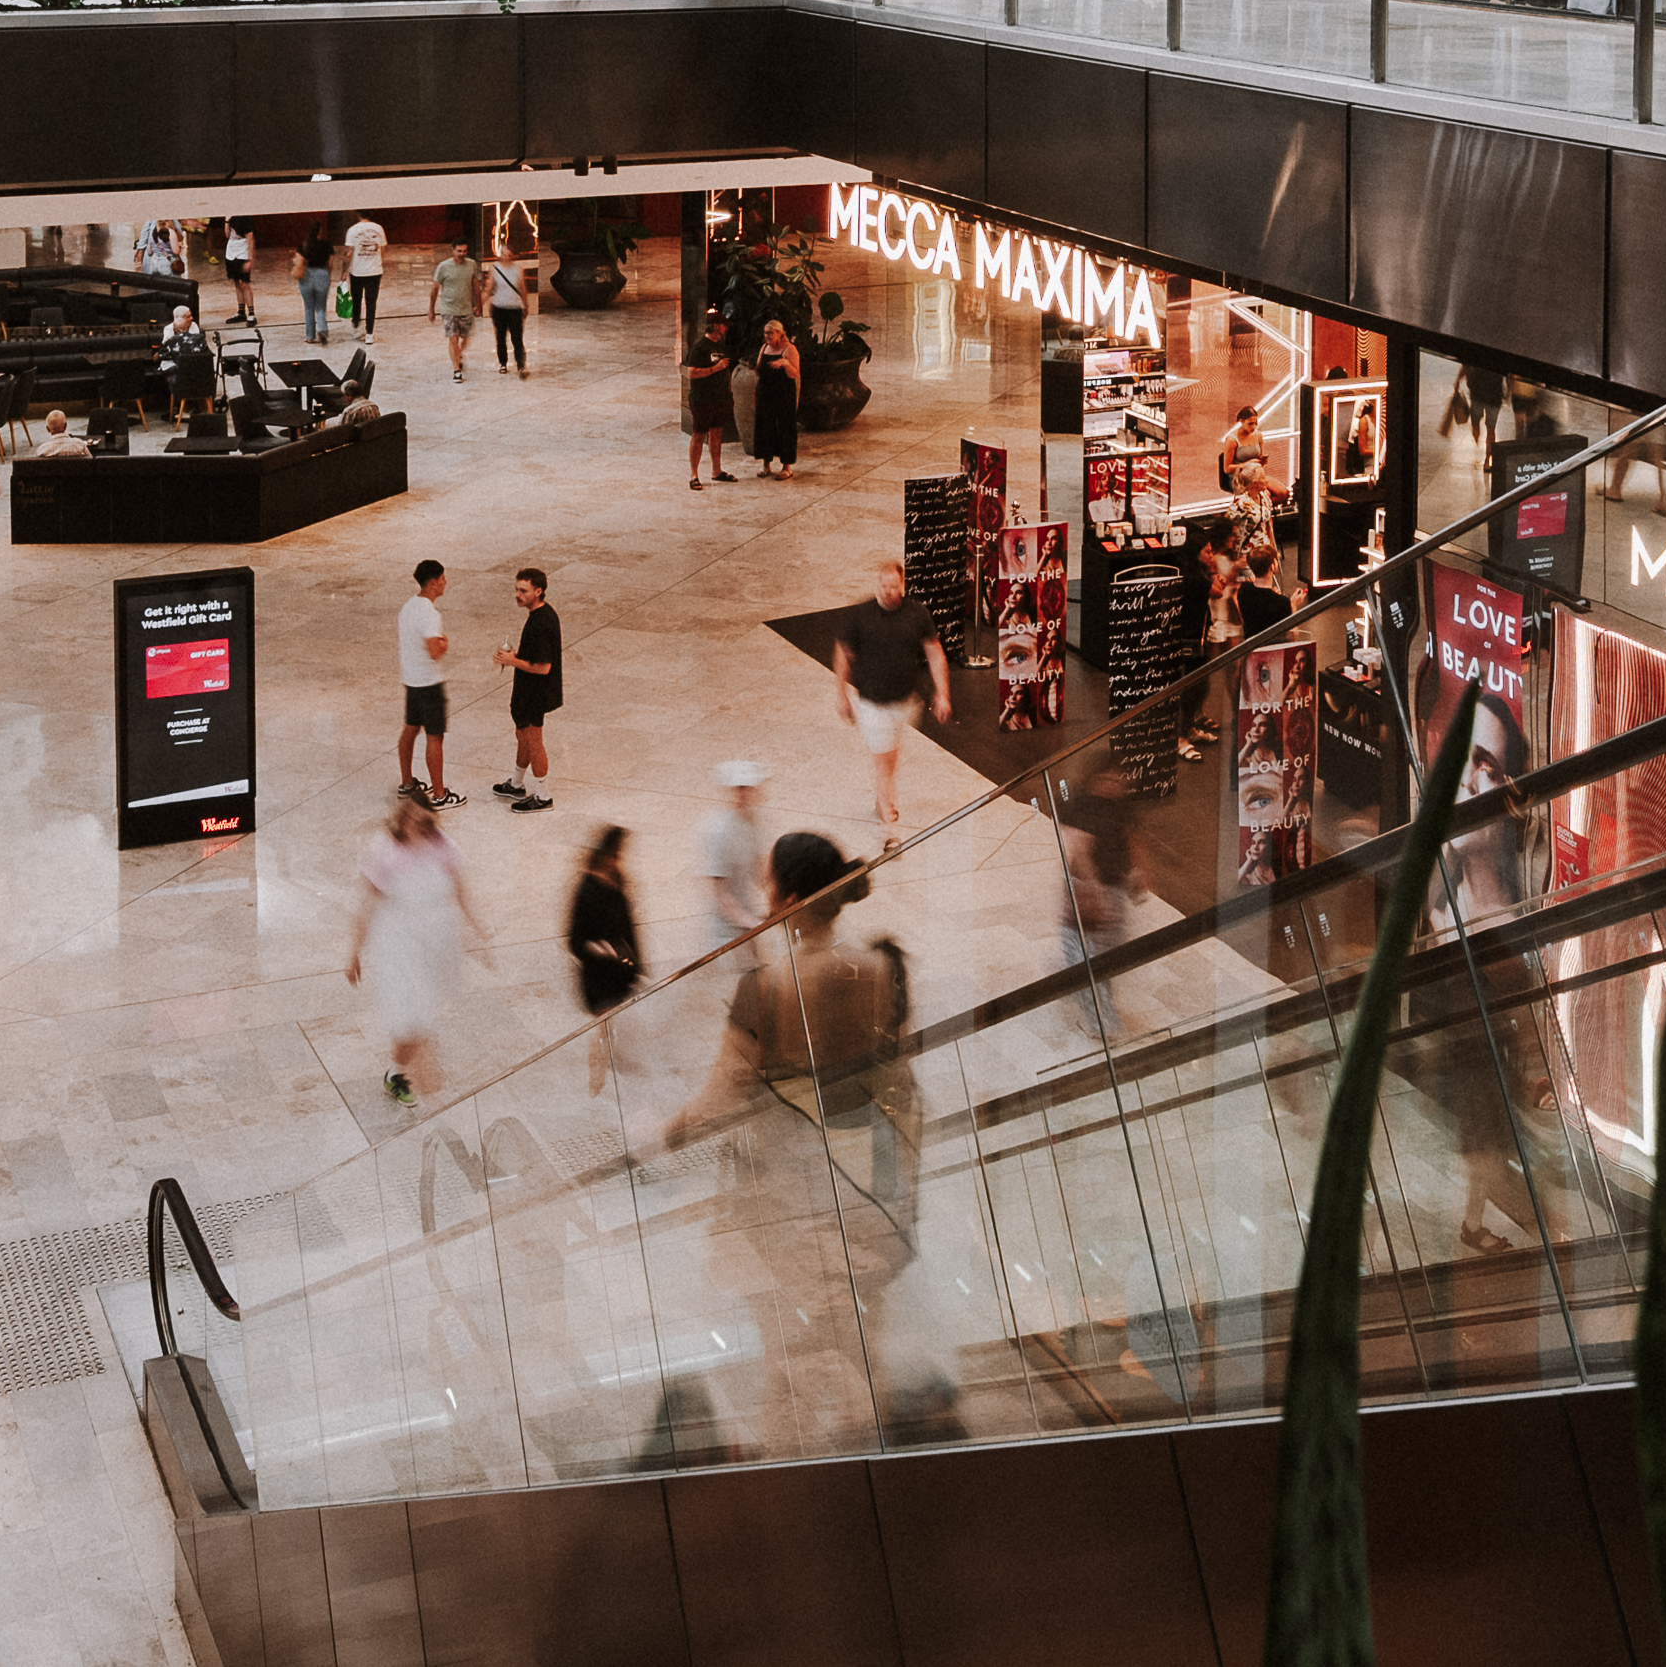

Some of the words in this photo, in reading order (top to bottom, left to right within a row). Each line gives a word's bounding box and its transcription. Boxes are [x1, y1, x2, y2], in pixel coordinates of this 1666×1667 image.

[828, 182, 962, 281] MECCA
[975, 220, 1161, 349] MAXIMA
[979, 485, 999, 498] THE
[984, 532, 998, 543] OF
[1009, 572, 1037, 585] FOR
[1039, 567, 1061, 582] THE
[1476, 584, 1487, 596] FOR
[1487, 587, 1497, 599] THE
[144, 608, 163, 618] Get
[164, 605, 173, 615] it
[174, 603, 197, 615] right
[199, 600, 220, 611] with
[222, 601, 229, 609] a
[141, 616, 187, 630] Westfield
[188, 614, 207, 624] Gift
[208, 610, 232, 622] Card
[1008, 621, 1043, 635] LOVE
[1046, 618, 1062, 631] OF
[1453, 593, 1517, 646] LOVE
[190, 651, 206, 659] GIFT
[206, 648, 225, 657] CARD
[1484, 641, 1492, 650] OF
[1008, 668, 1062, 686] BEAUTY
[1251, 701, 1282, 715] FOR
[1285, 695, 1310, 712] THE
[166, 718, 201, 729] PURCHASE
[169, 725, 208, 736] CONCIERGE
[1323, 722, 1340, 738] NEW
[1342, 732, 1362, 749] NOW
[1249, 758, 1290, 774] LOVE
[1293, 754, 1310, 768] OF
[200, 817, 240, 832] Westfield
[1250, 813, 1309, 833] BEAUTY
